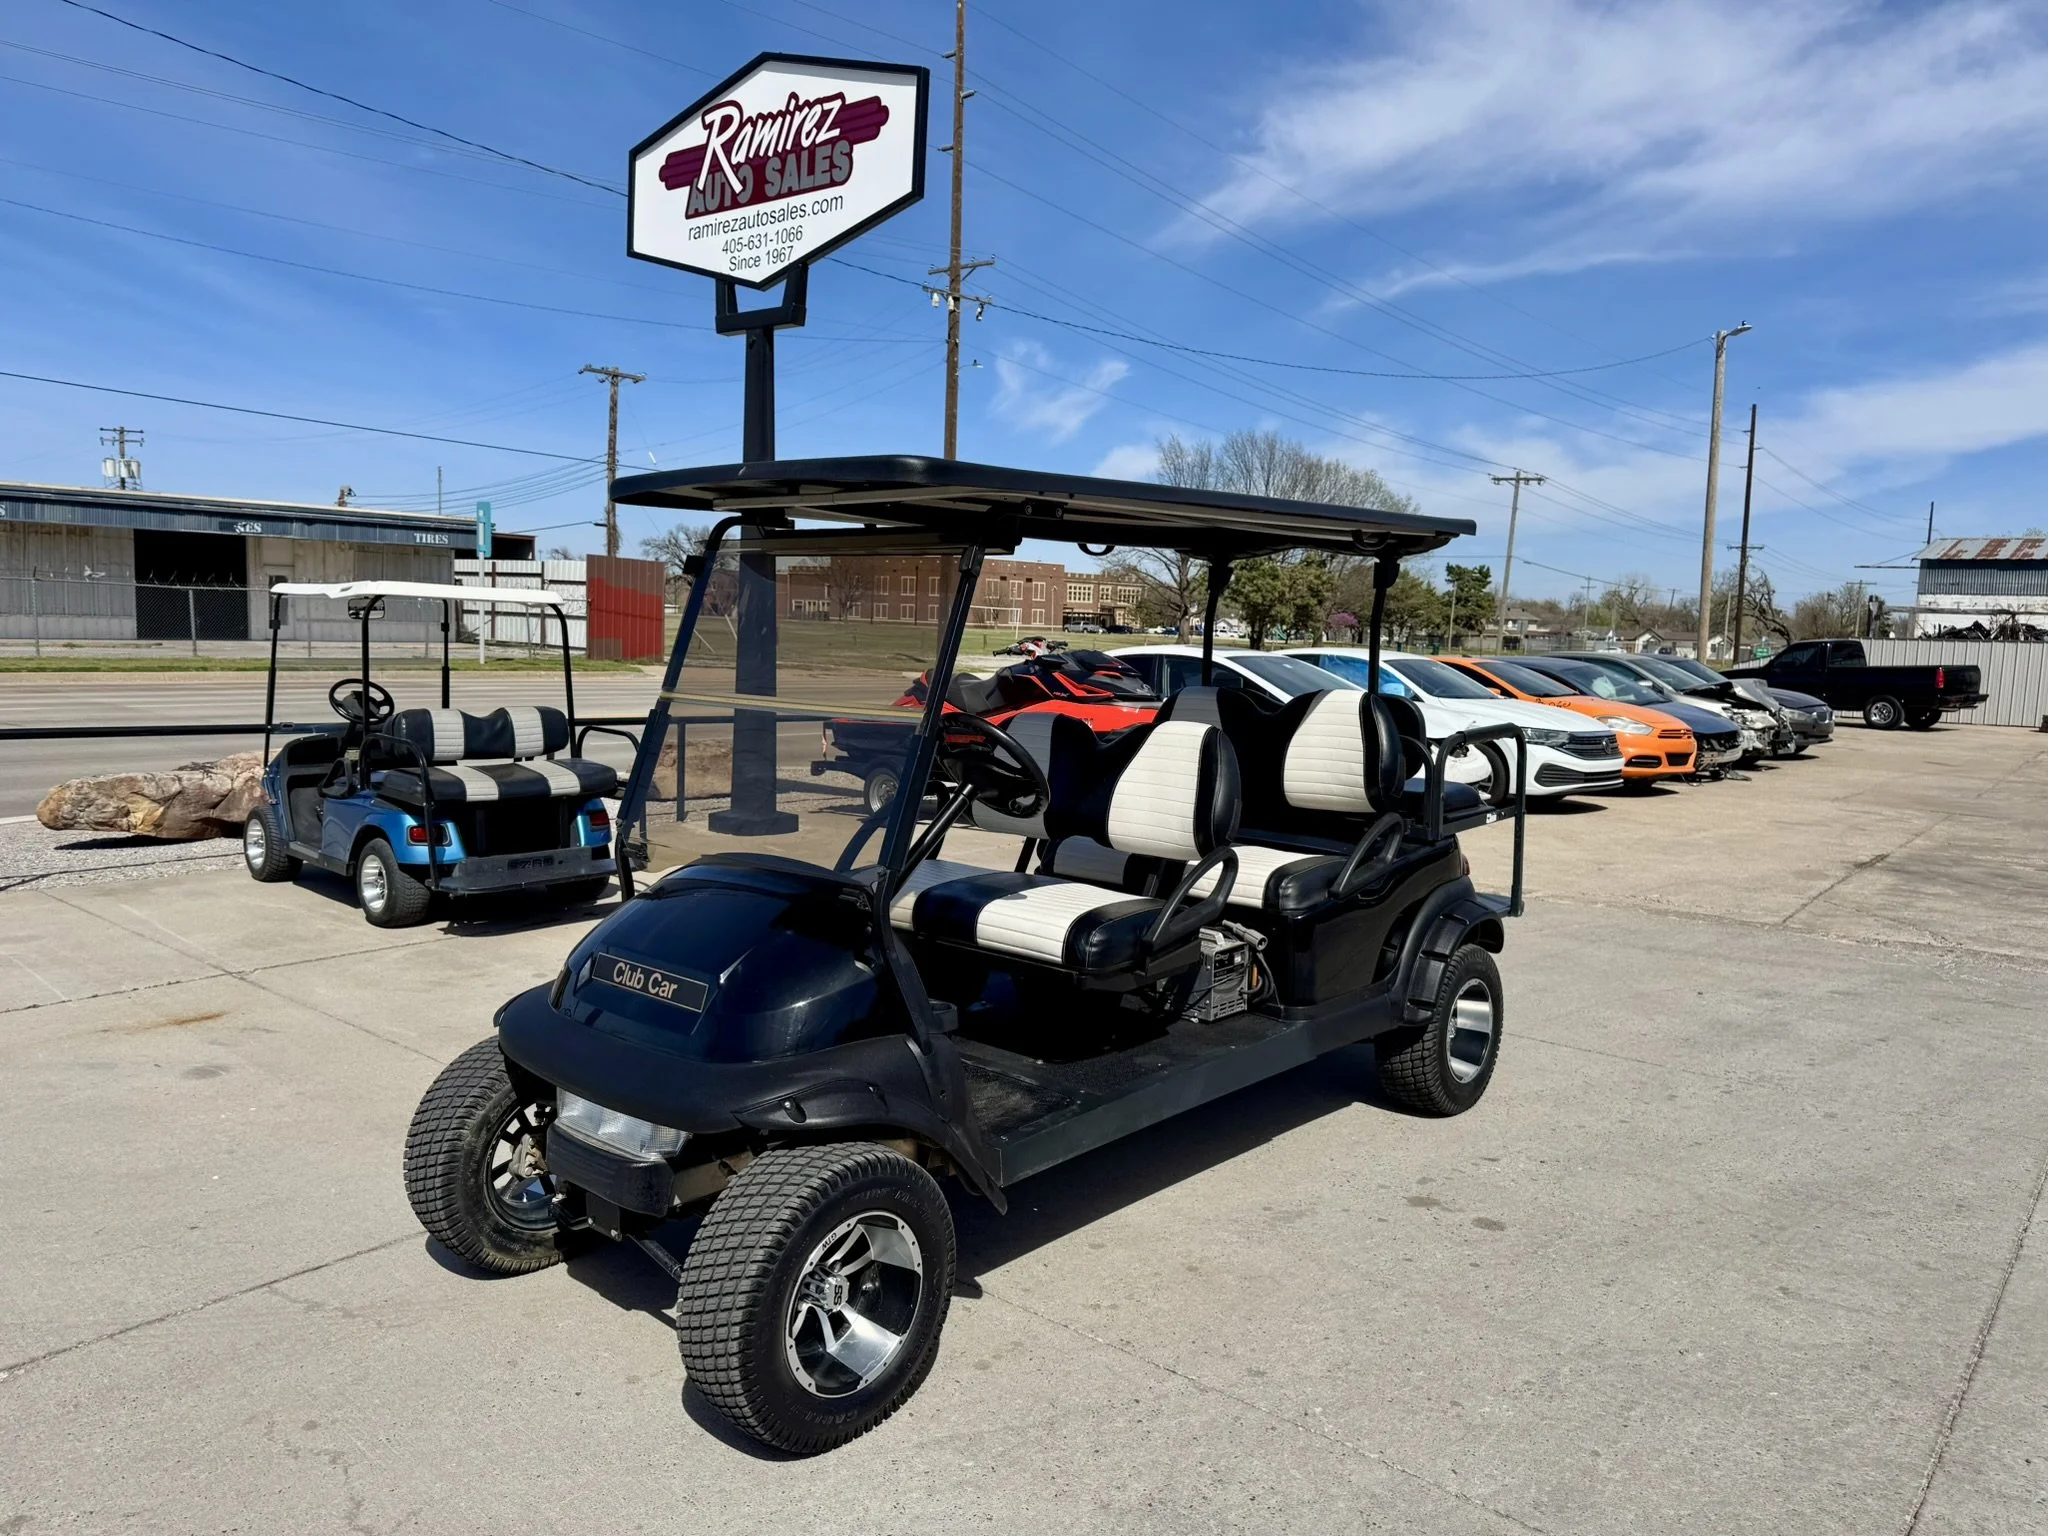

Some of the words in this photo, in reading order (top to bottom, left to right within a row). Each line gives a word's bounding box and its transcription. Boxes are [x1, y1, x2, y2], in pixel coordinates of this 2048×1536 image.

[697, 97, 843, 194] Ramirez
[687, 164, 754, 215] AUTO
[764, 140, 850, 198] SALES
[688, 195, 844, 241] ramirezautosales.com
[722, 225, 803, 255] 405-631-1066
[729, 255, 761, 272] Since
[765, 246, 794, 266] 1967
[413, 532, 449, 544] TIRES
[613, 962, 645, 989] Club
[648, 973, 678, 999] Car
[821, 1232, 837, 1251] GTW
[833, 1284, 843, 1306] SS
